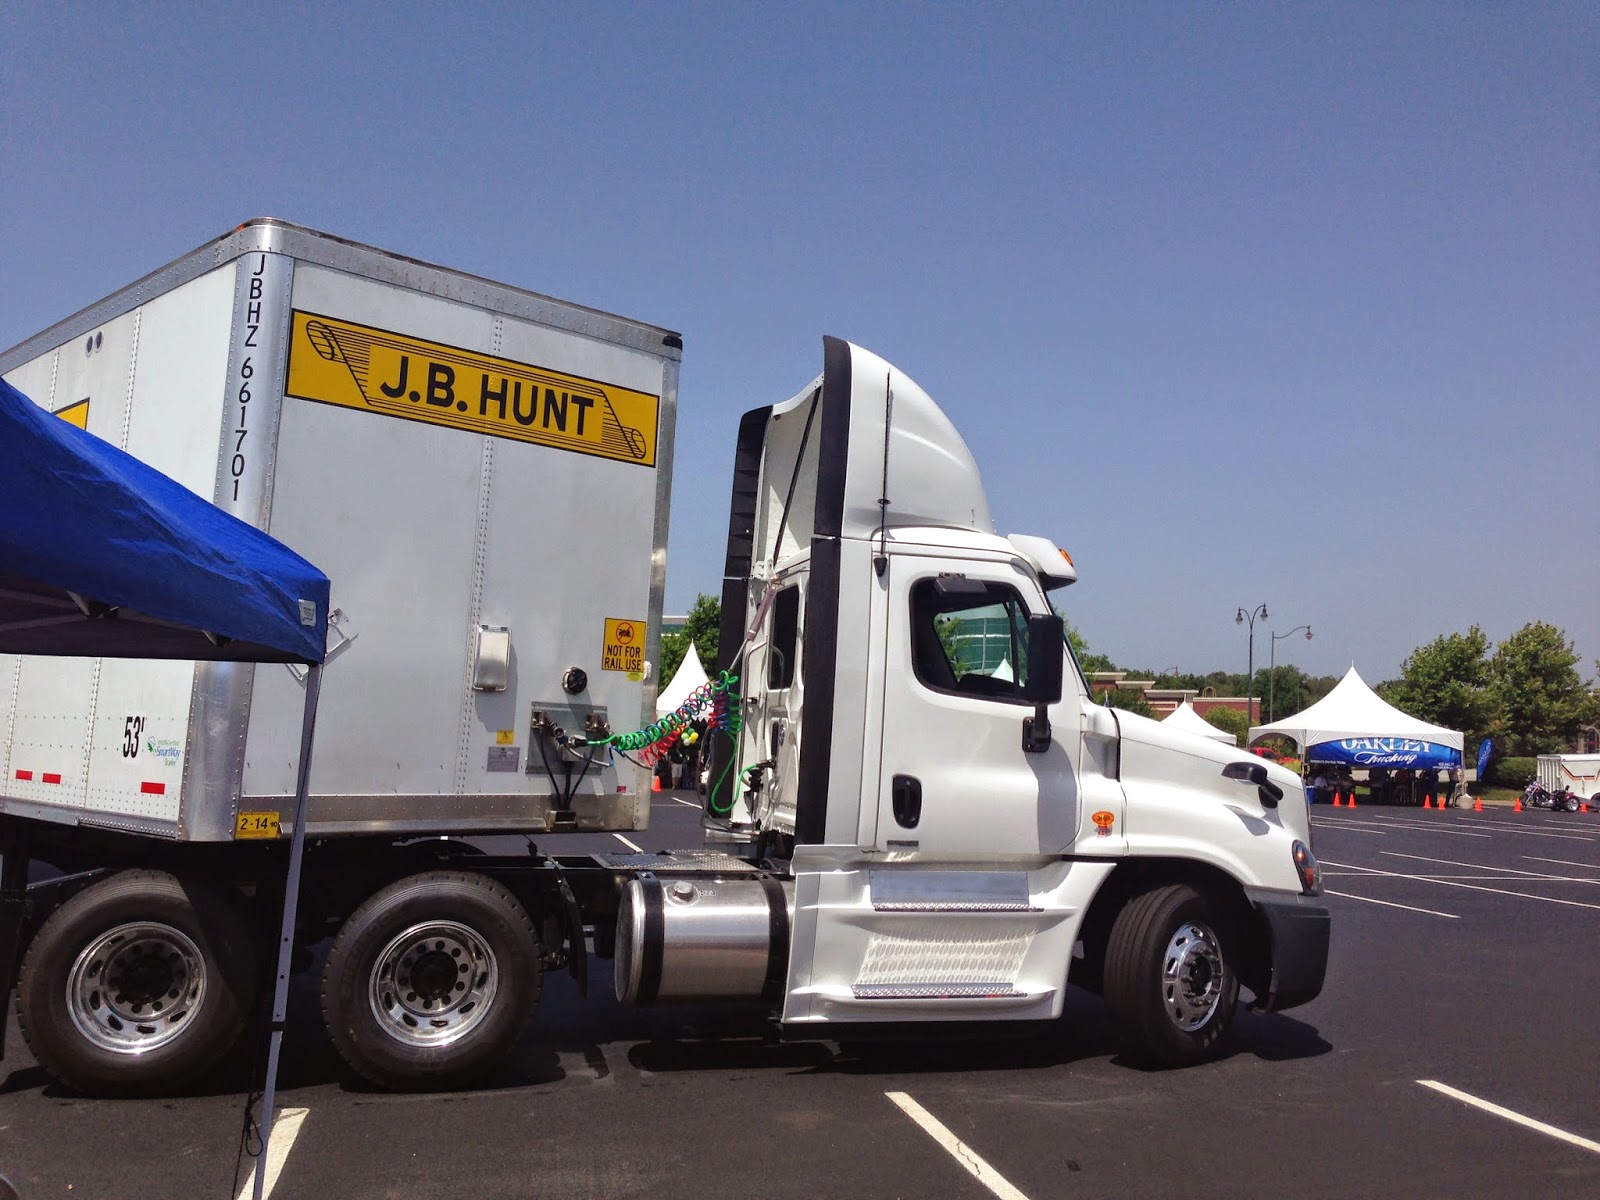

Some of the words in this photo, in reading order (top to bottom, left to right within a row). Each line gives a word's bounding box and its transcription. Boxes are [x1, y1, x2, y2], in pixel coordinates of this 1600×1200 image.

[244, 254, 265, 347] JBHZ
[380, 356, 469, 412] J.B.
[480, 374, 595, 436] HUNT
[231, 357, 253, 501] 661701
[607, 645, 623, 657] NOT
[625, 646, 641, 658] FOR
[605, 657, 623, 669] RAIL
[626, 659, 642, 670] USE
[1341, 738, 1430, 753] OAKLEY
[1353, 751, 1418, 764] Trucking
